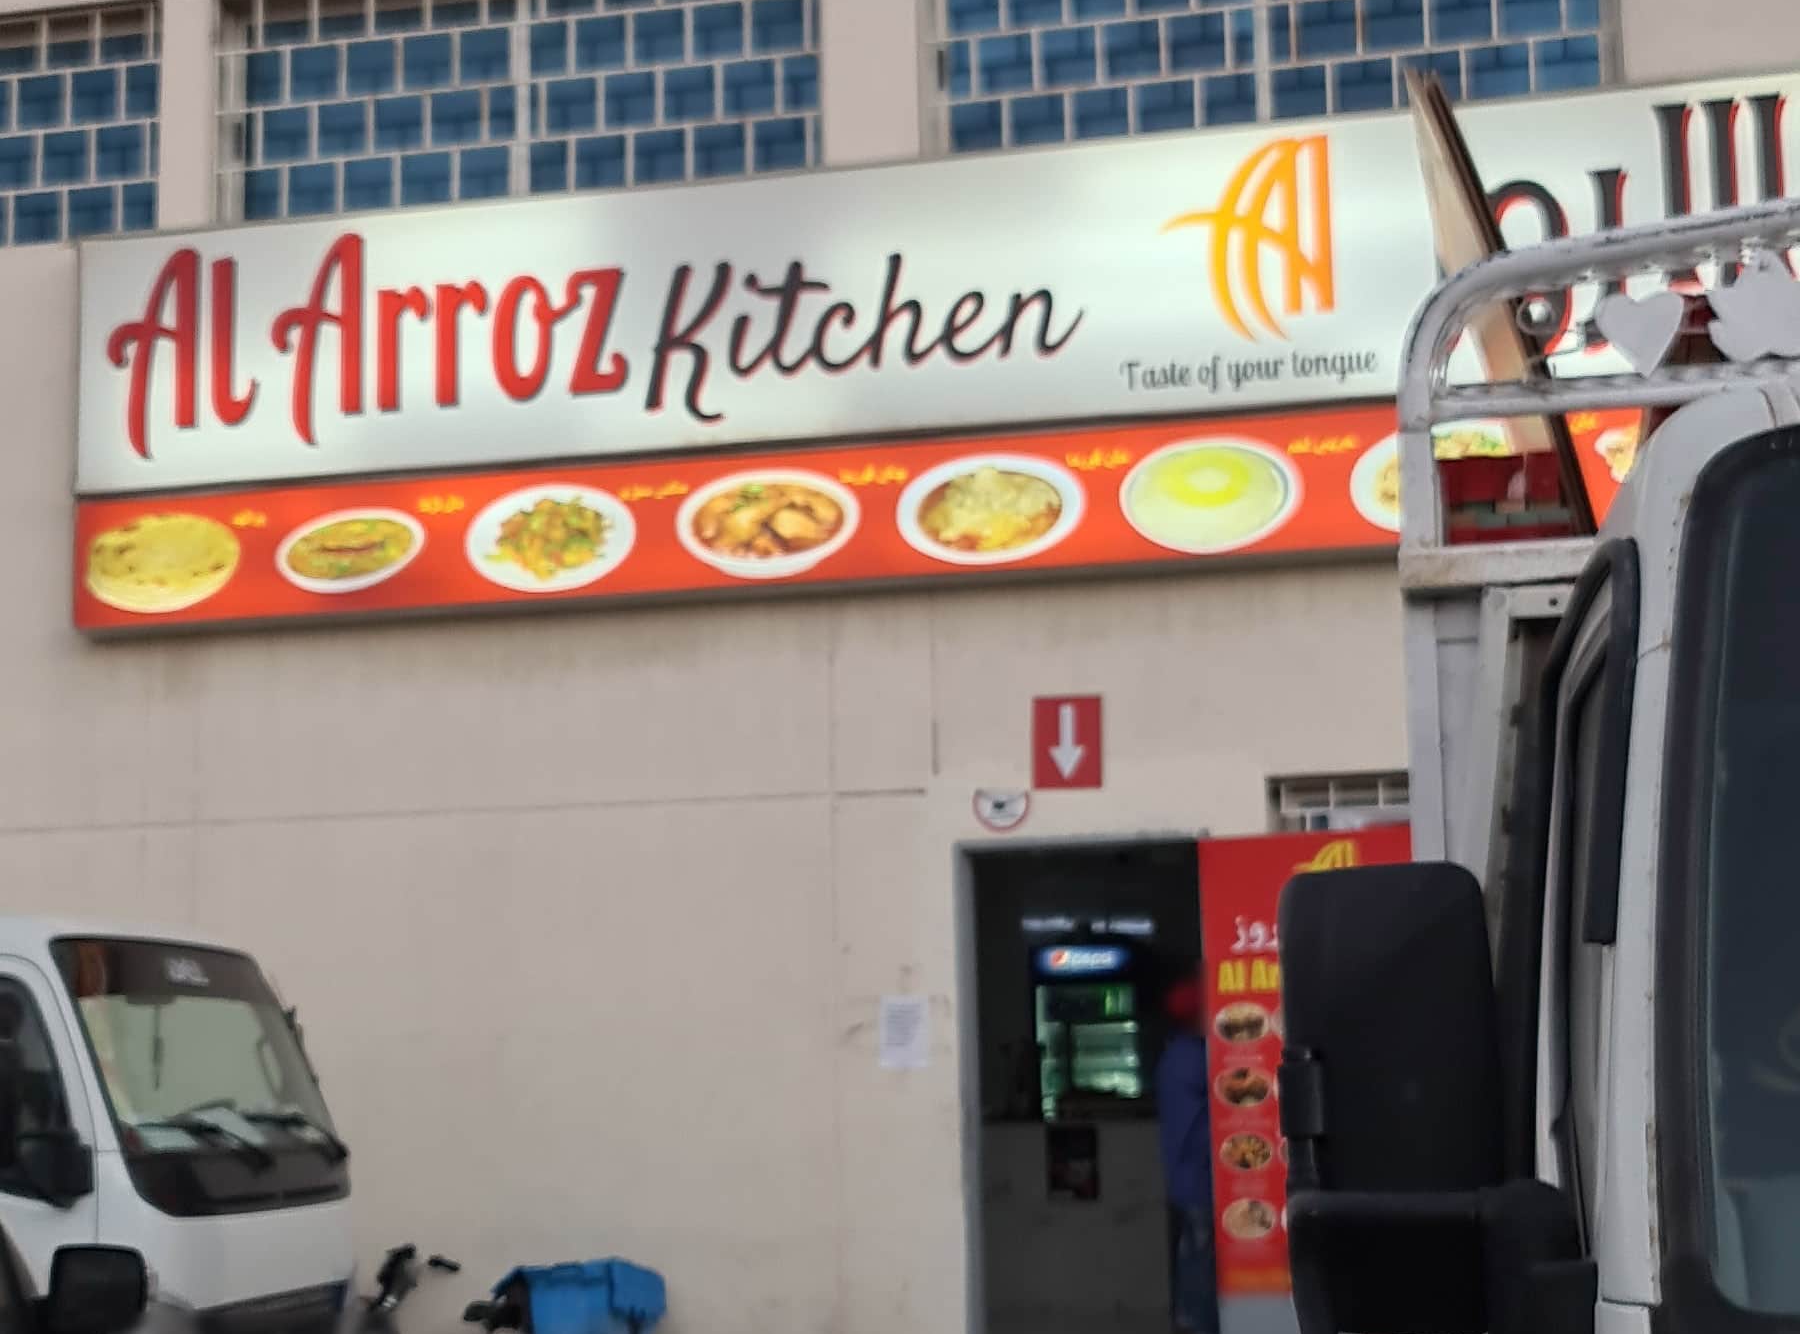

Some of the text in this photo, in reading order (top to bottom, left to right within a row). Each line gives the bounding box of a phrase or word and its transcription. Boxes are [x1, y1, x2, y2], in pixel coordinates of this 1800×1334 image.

[107, 233, 1084, 459] Al Arroz Kitchen
[1120, 351, 1376, 393] Taste of your tongue
